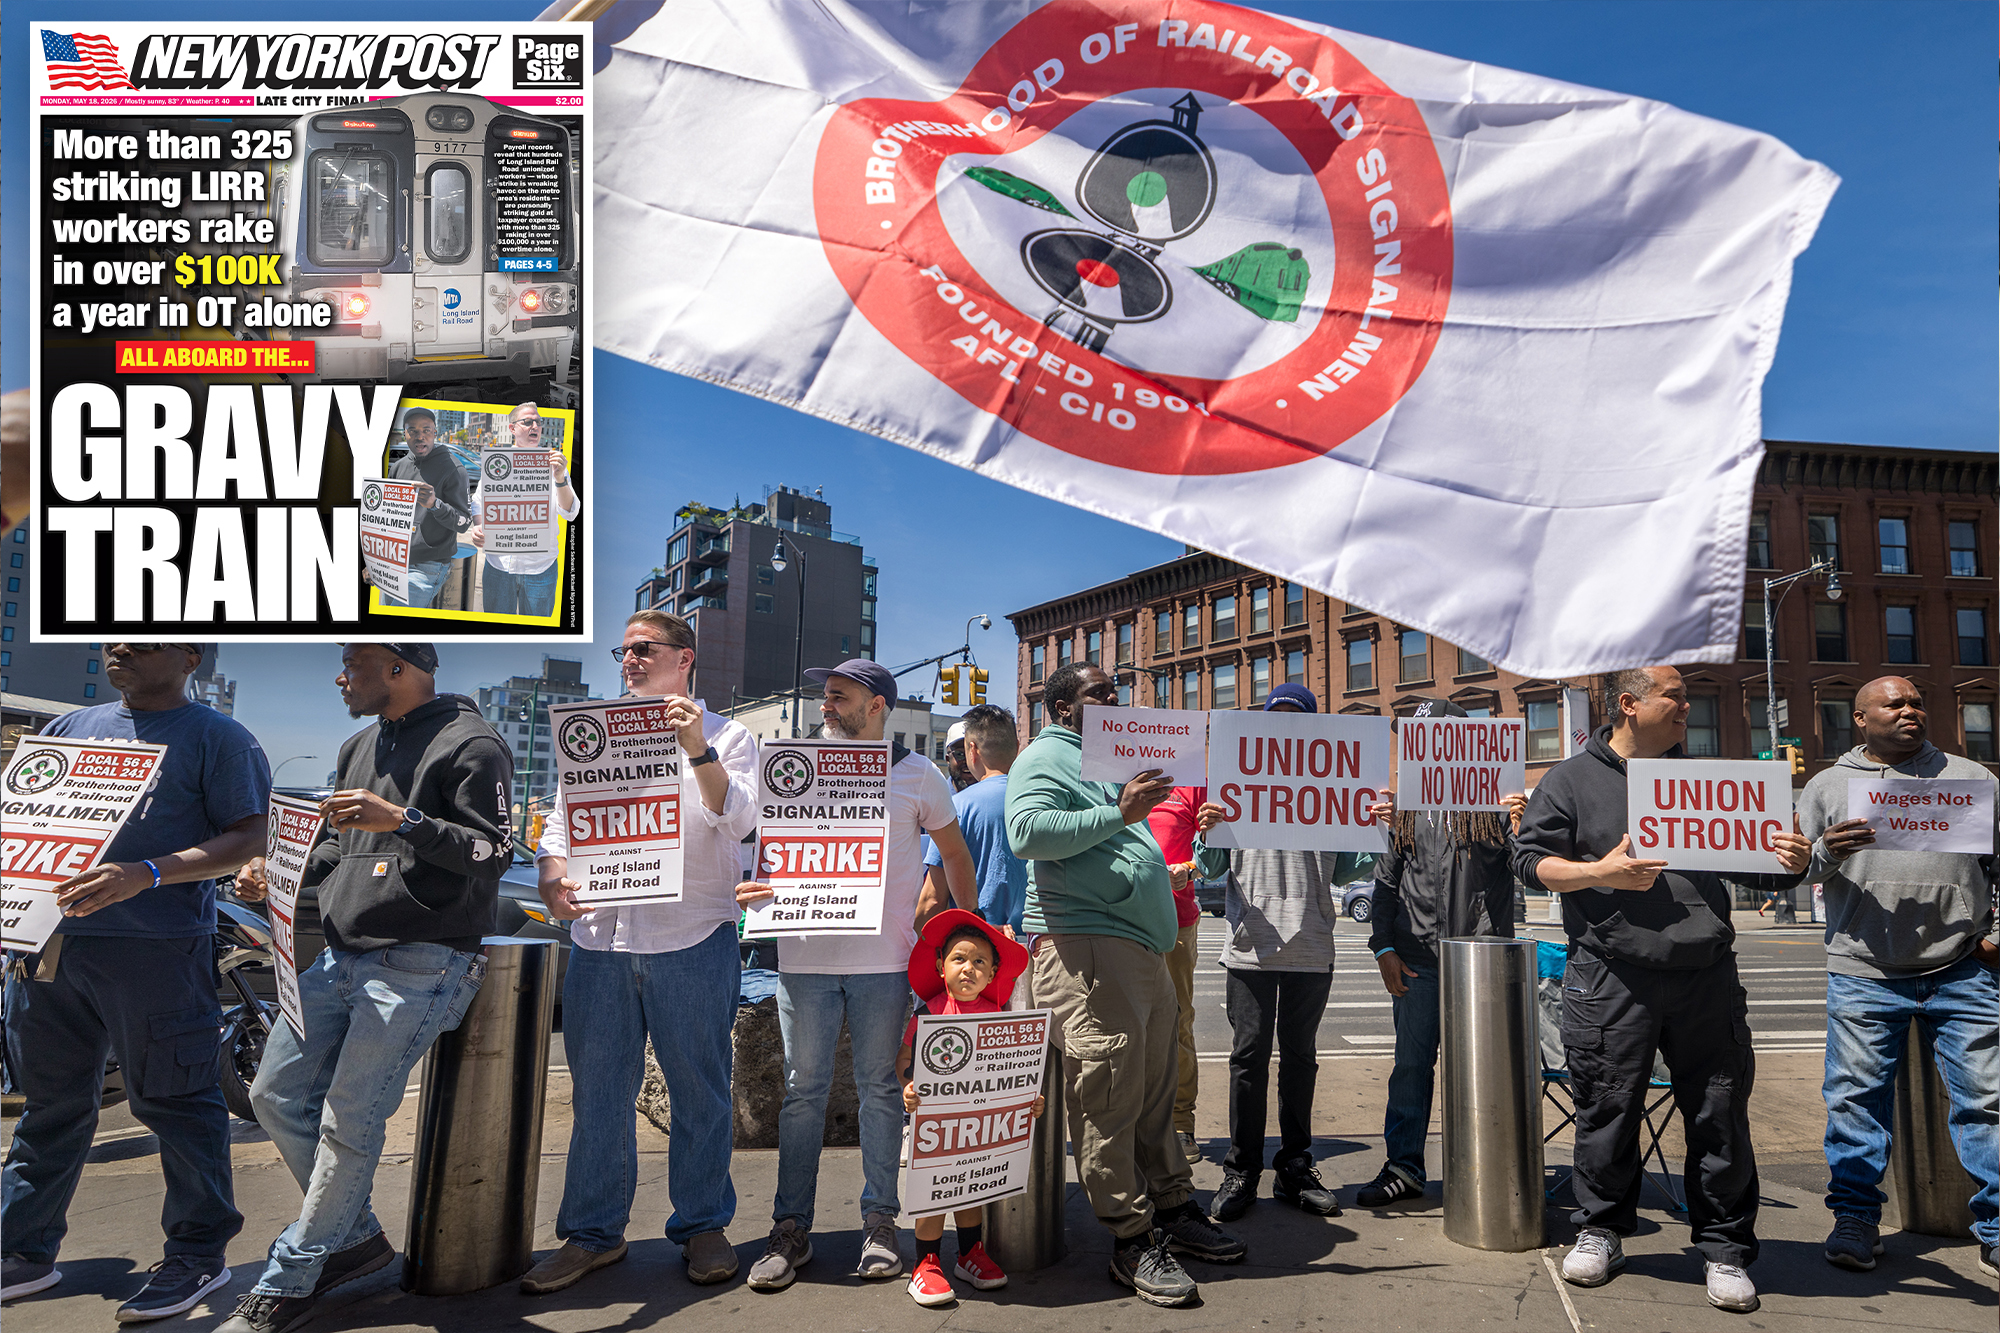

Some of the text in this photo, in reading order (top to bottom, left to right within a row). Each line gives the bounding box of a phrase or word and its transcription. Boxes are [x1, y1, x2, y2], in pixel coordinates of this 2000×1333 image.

[865, 19, 1403, 403] BROTHERHOOD OF RAILROAD SIGNALMEN
[920, 264, 1095, 388] FOUNDED
[950, 332, 1021, 384] AFL
[1058, 393, 1138, 432] CIO
[607, 711, 644, 724] LOCAL
[646, 709, 661, 720] 56
[610, 720, 671, 734] LOCAL 241
[1102, 720, 1190, 736] No Contract
[610, 735, 676, 750] Brotherhood
[1403, 724, 1521, 762] NO CONTRACT
[623, 746, 677, 760] Railroad
[818, 753, 886, 764] LOCAL 56 &
[1114, 744, 1176, 758] No Work
[1238, 736, 1360, 779] UNION
[78, 753, 154, 768] LOCAL 56 &
[75, 765, 116, 776] LOCAL
[119, 768, 146, 778] 241
[564, 762, 678, 786] SIGNALMEN
[821, 764, 884, 774] LOCAL 241
[63, 780, 142, 792] Brotherhood
[817, 778, 886, 788] Brotherhood
[1421, 766, 1502, 806] NO WORK
[68, 791, 135, 804] Railroad
[829, 789, 886, 800] Railroad
[1654, 778, 1766, 814] UNION
[1868, 791, 1972, 808] Wages Not
[762, 805, 885, 820] SIGNALMEN
[1220, 783, 1377, 827] STRONG
[282, 811, 317, 830] LOCAL 56 &
[570, 801, 678, 841] STRIKE
[1889, 816, 1950, 832] Waste
[280, 825, 310, 842] LOCAL 241
[1, 838, 97, 877] RIKE
[277, 842, 308, 859] Brotherhood
[608, 848, 642, 856] AGAINST
[761, 842, 880, 874] STRIKE
[279, 856, 302, 873] Railroad
[589, 859, 661, 876] Long Island
[588, 876, 660, 892] Rail Road
[774, 894, 858, 908] Long Island
[772, 908, 856, 921] Rail Road
[978, 1022, 1044, 1038] LOCAL 56 &
[980, 1033, 1041, 1048] LOCAL 241
[976, 1047, 1042, 1062] Brotherhood
[986, 1058, 1040, 1073] Railroad
[918, 1072, 1039, 1098] SIGNALMEN
[916, 1107, 1030, 1154] STRIKE
[956, 1154, 992, 1166] AGAINST
[932, 1161, 1010, 1186] Long Island
[930, 1176, 1007, 1201] Rail Road
